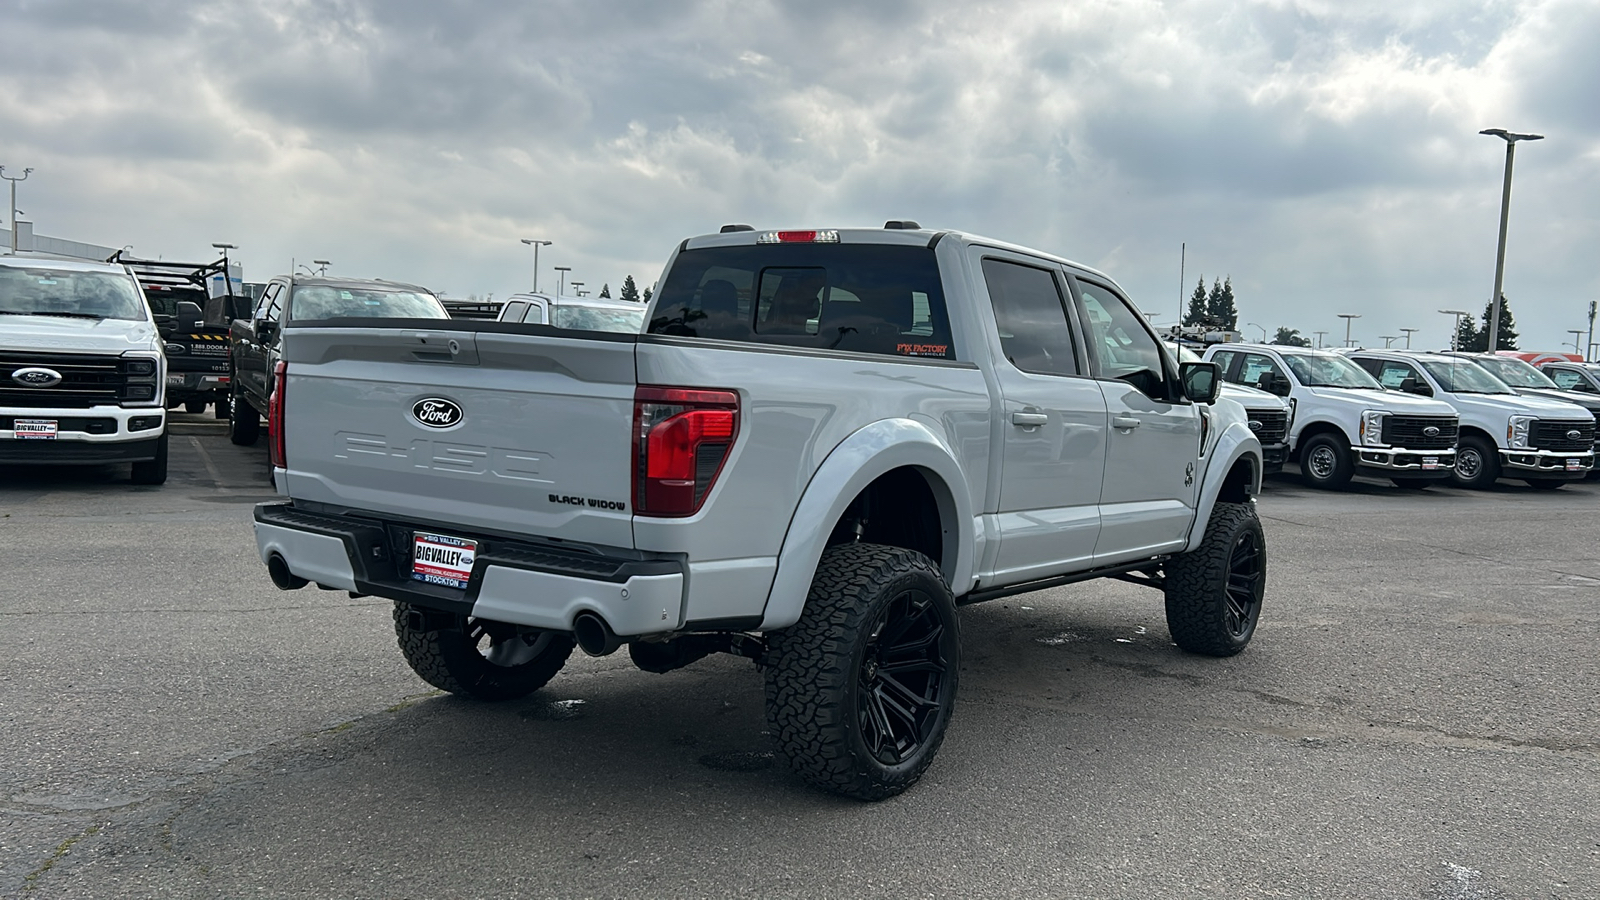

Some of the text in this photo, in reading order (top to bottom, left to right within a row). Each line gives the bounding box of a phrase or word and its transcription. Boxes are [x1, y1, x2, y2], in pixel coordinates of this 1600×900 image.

[913, 344, 947, 353] FACTORY
[25, 372, 48, 382] Ford
[420, 401, 453, 422] Ford
[548, 494, 626, 511] BLACK WIDOW
[440, 538, 461, 546] VALLEY
[416, 546, 462, 566] BIGVALLEY
[424, 574, 460, 588] STOCKTON
